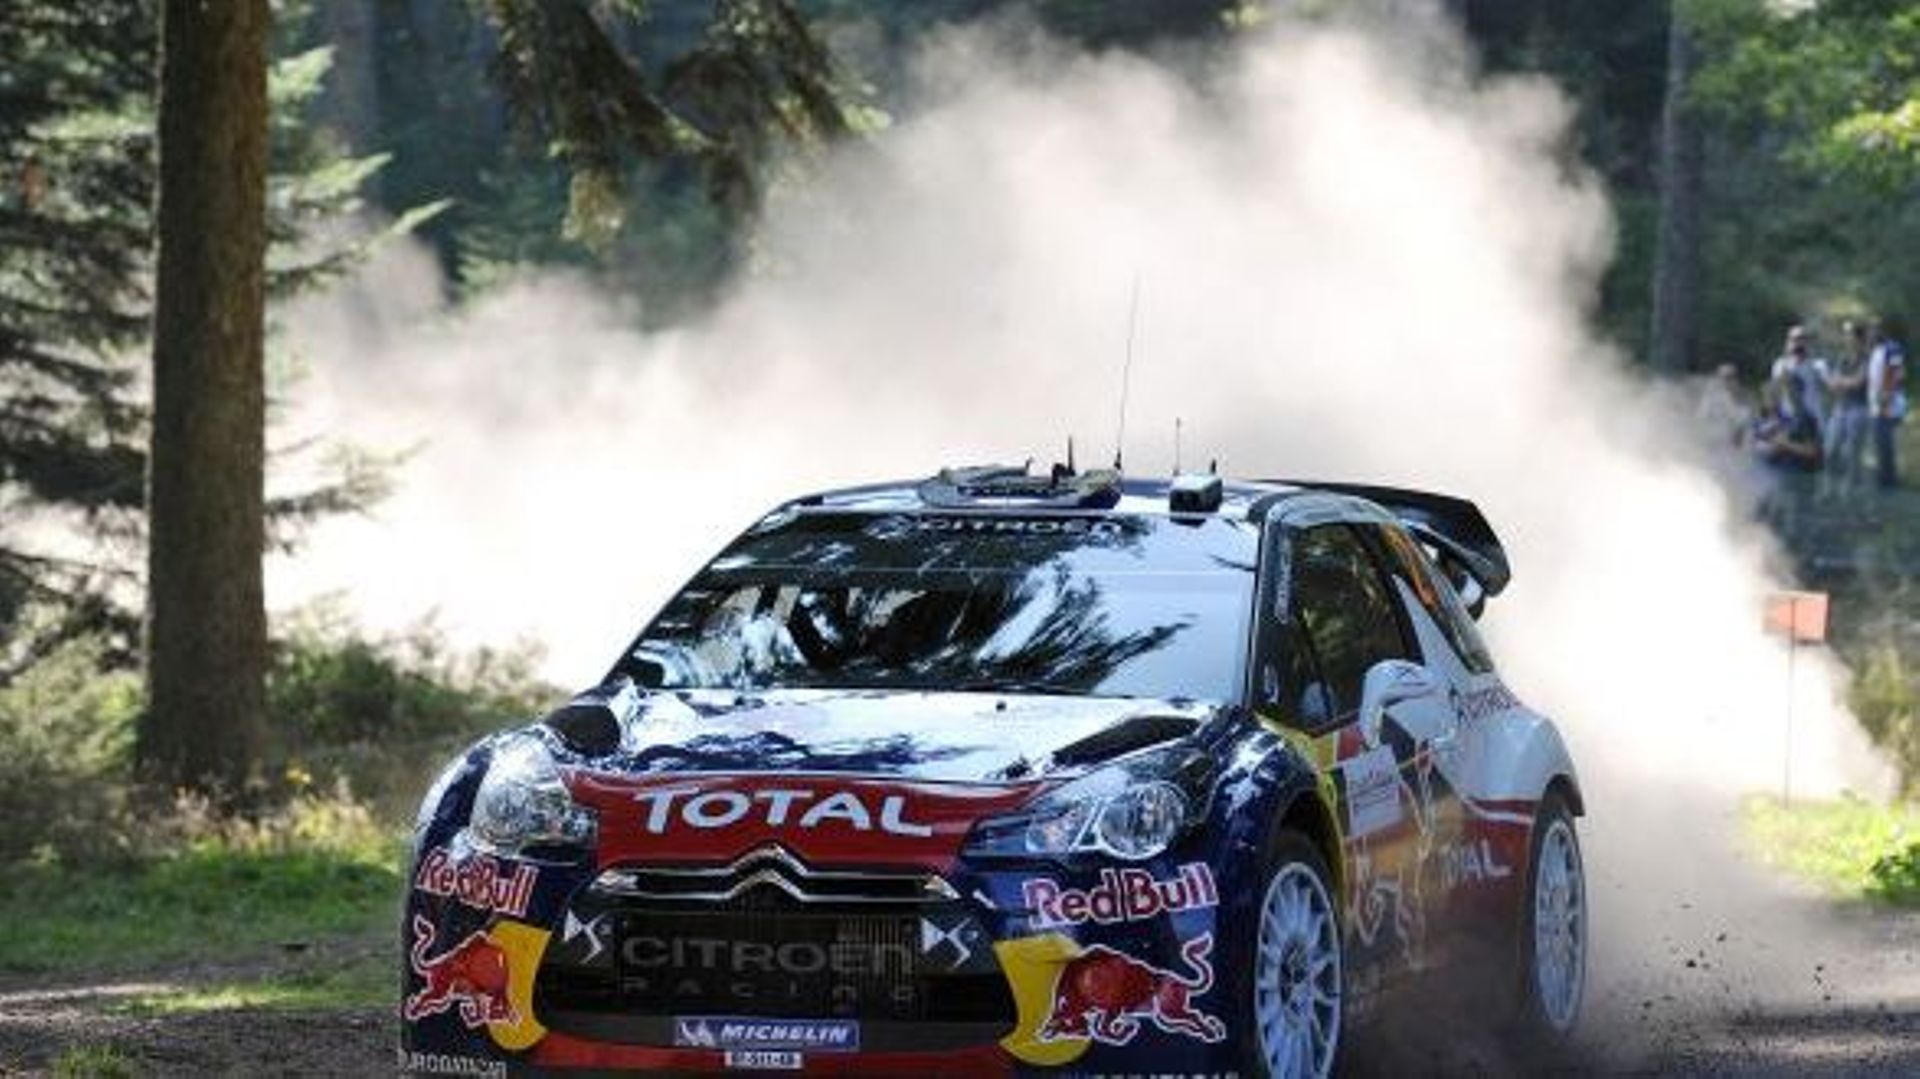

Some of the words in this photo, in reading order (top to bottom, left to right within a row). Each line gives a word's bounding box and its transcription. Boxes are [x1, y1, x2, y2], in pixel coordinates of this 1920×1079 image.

[634, 786, 934, 837] TOTAL
[414, 845, 479, 906] Red
[474, 854, 540, 917] Bull
[1022, 868, 1123, 928] Red
[1121, 862, 1220, 922] Bull
[721, 1024, 848, 1043] MICHELIN
